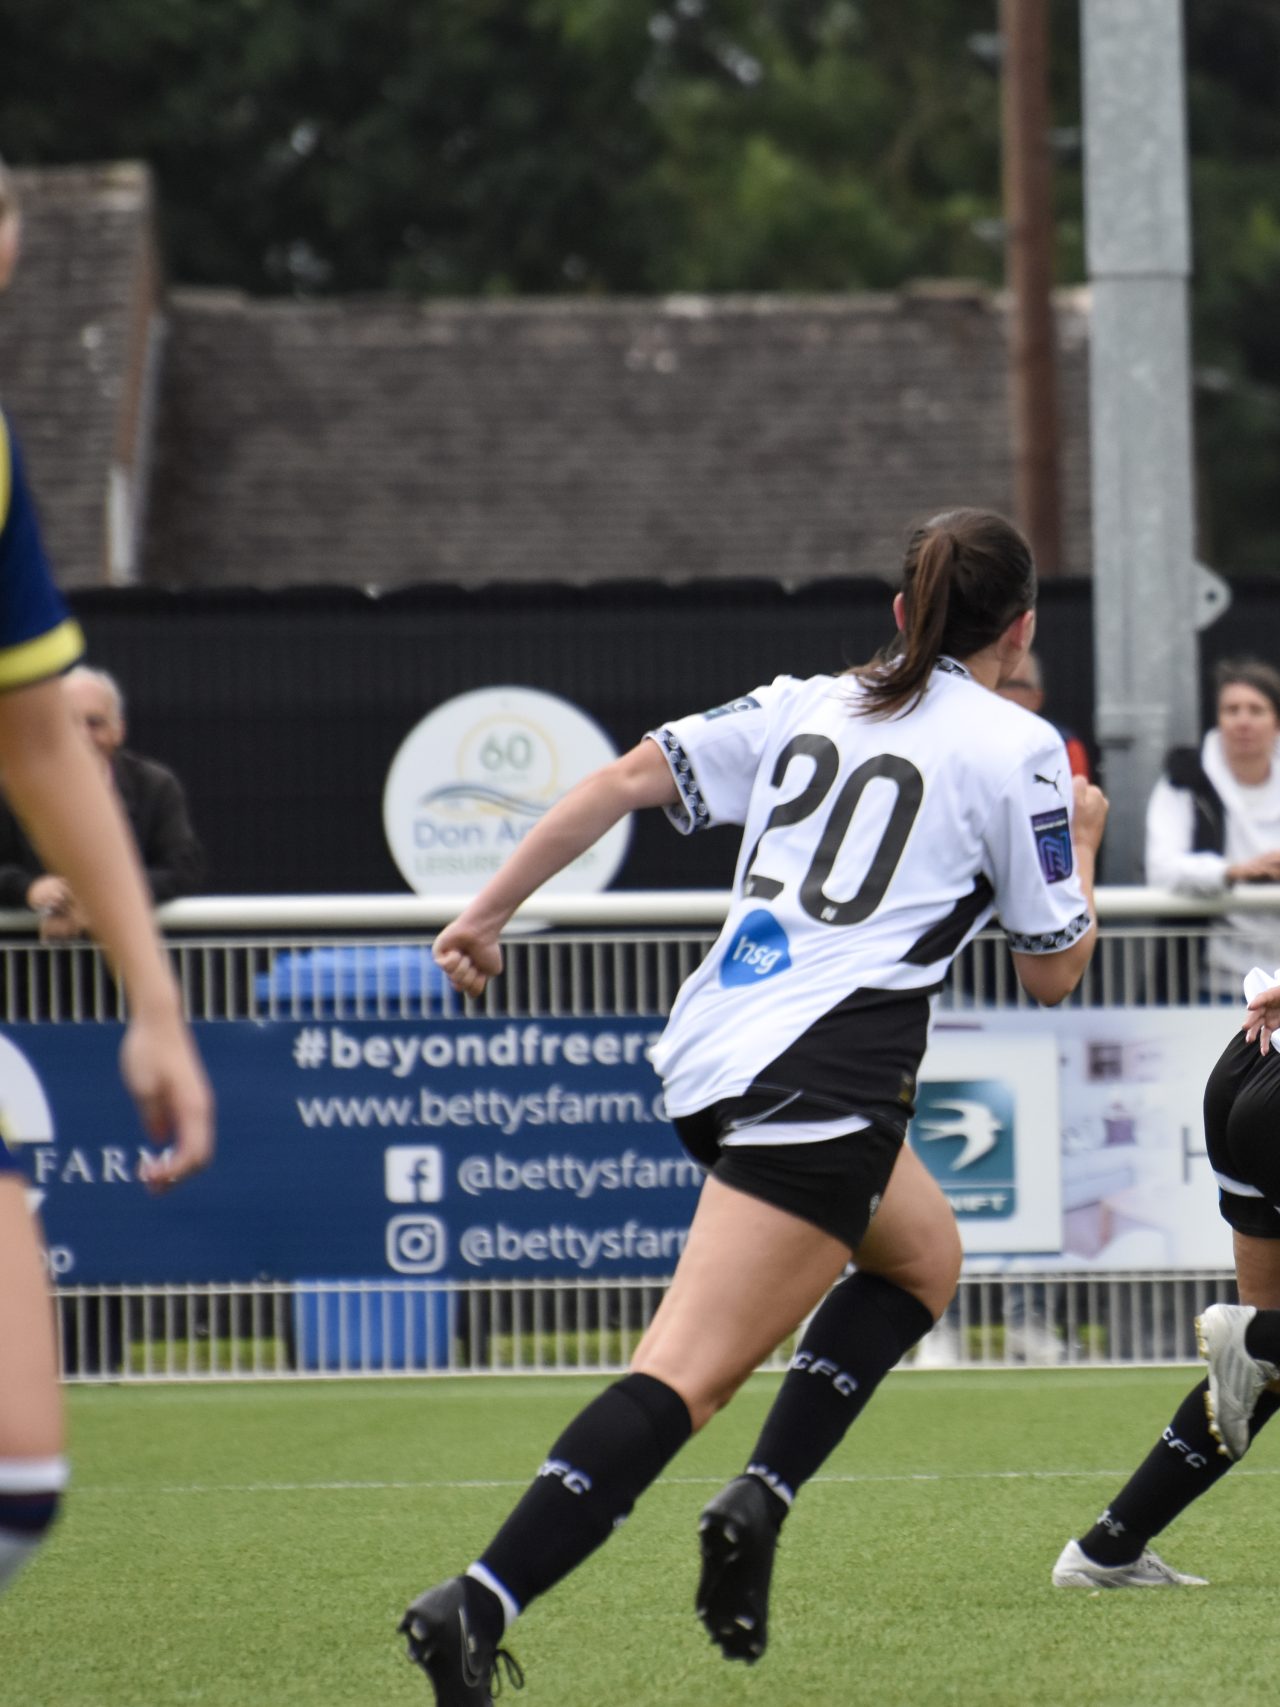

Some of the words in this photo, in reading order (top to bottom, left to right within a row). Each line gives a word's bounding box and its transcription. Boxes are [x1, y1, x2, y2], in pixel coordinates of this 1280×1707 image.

[481, 734, 532, 770] 60
[413, 819, 484, 849] Don
[742, 733, 924, 927] 20
[731, 935, 783, 975] hsg
